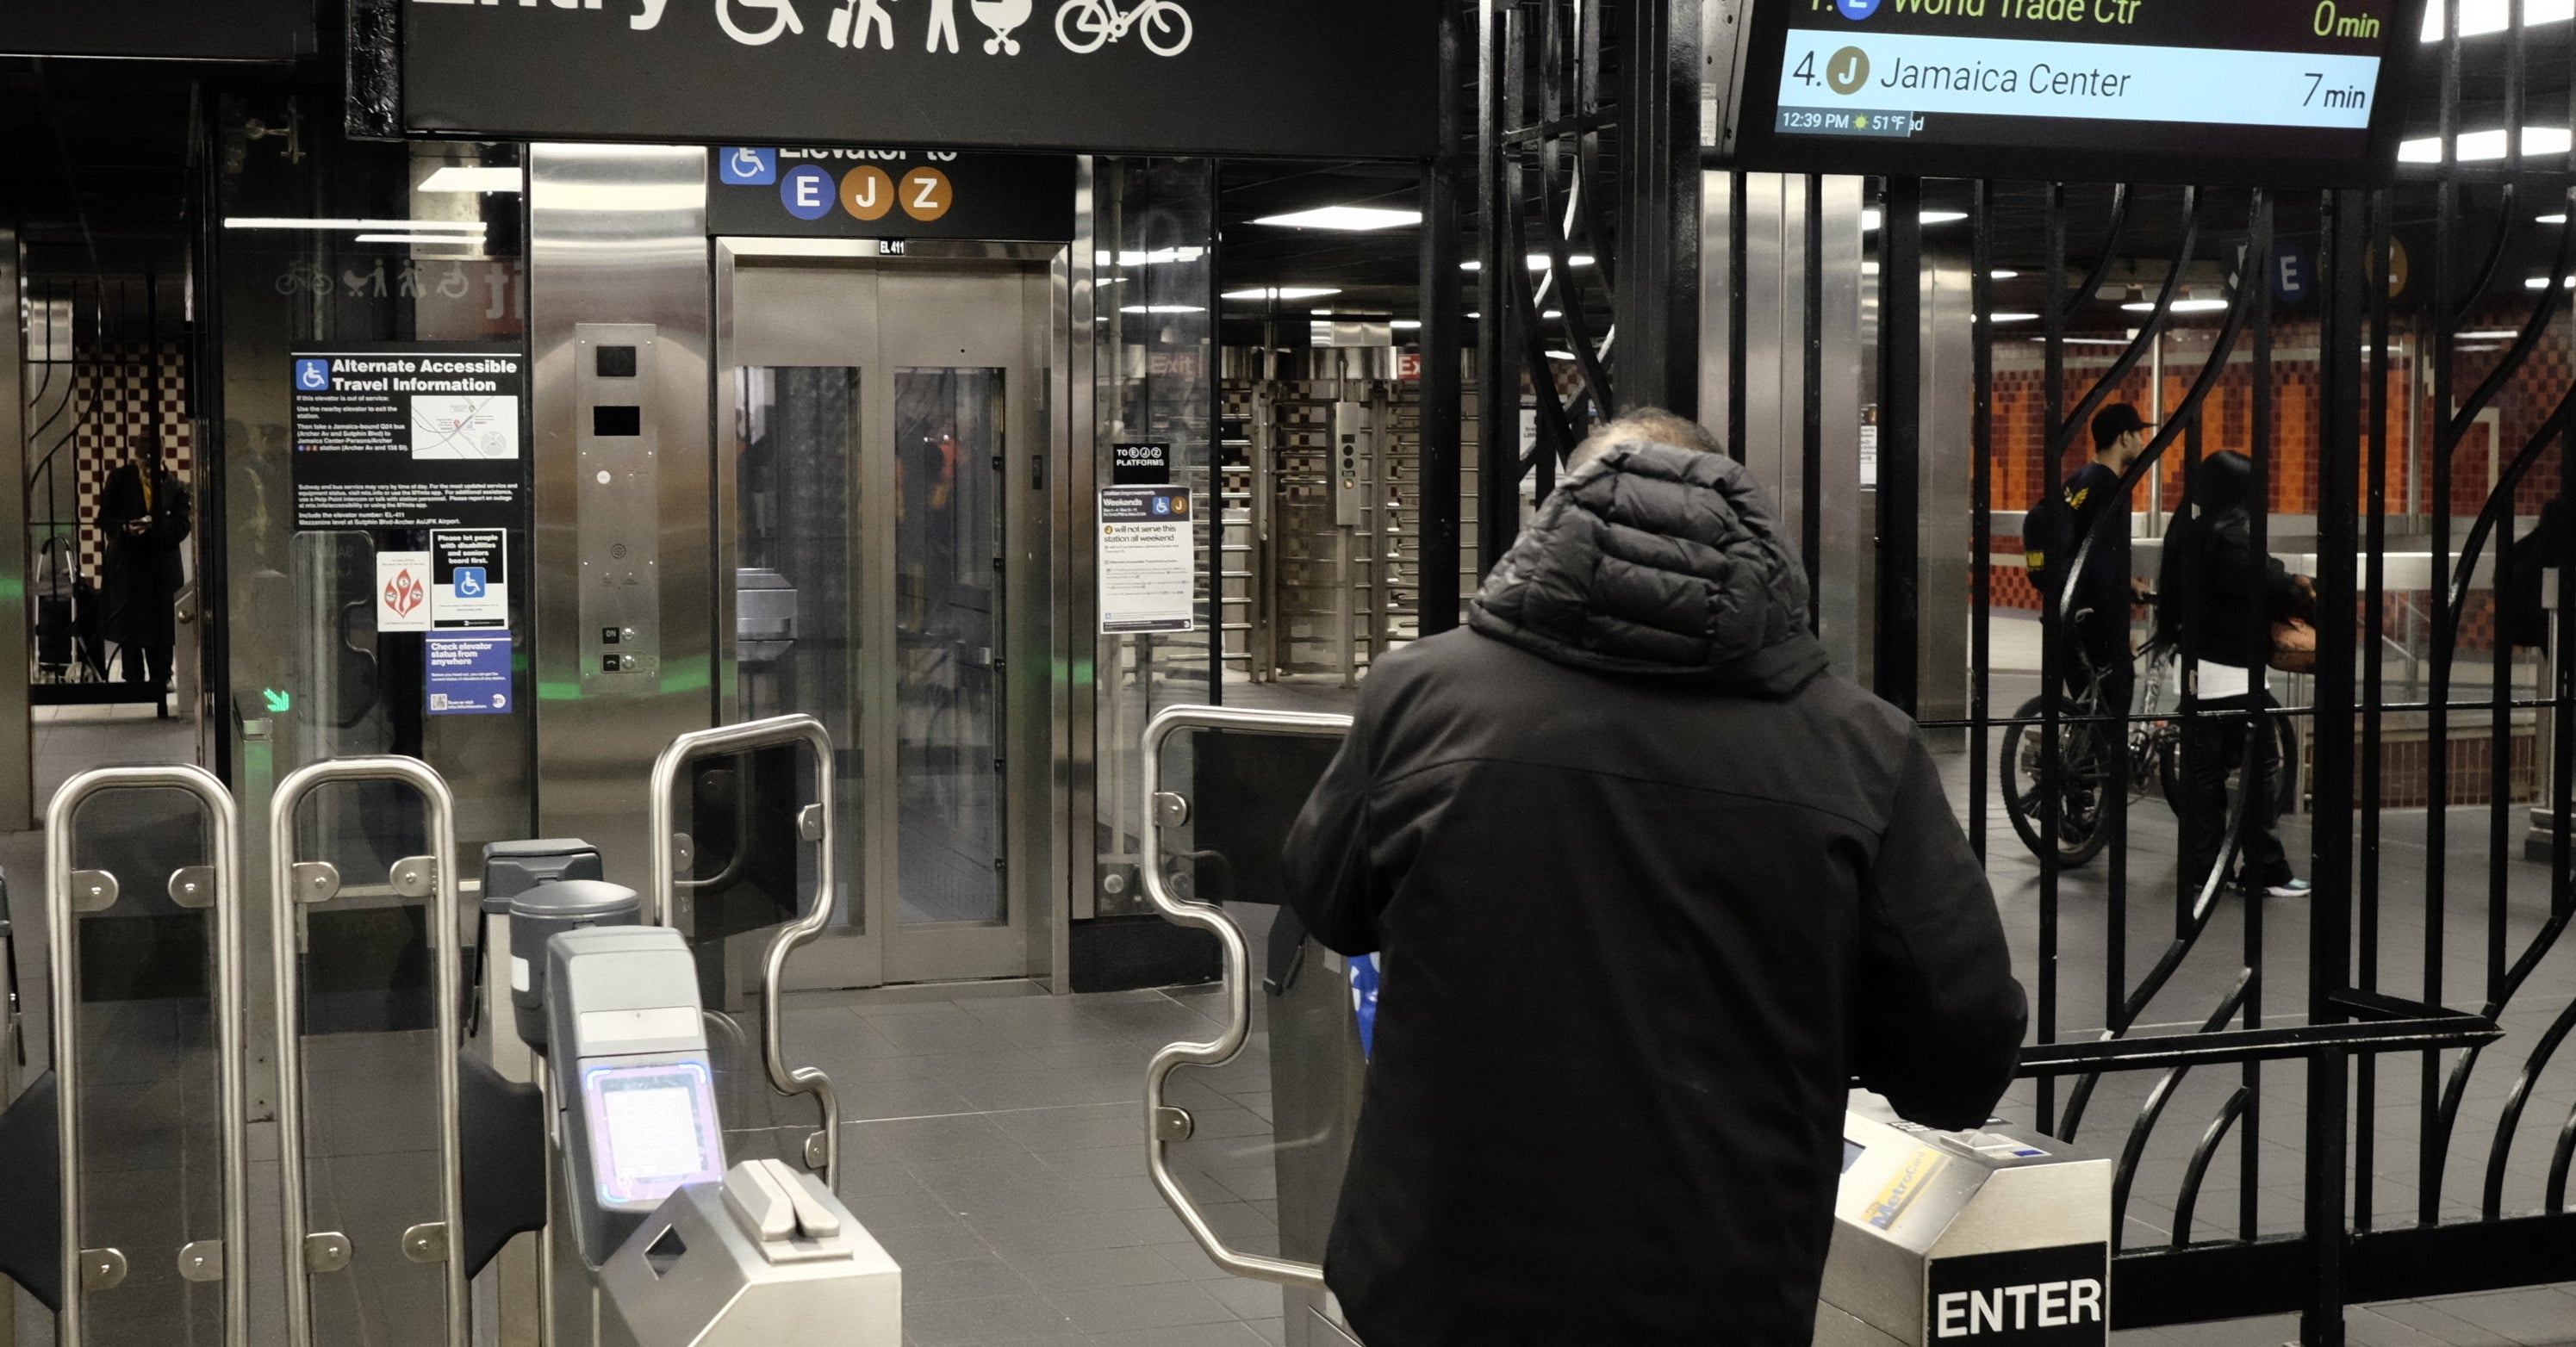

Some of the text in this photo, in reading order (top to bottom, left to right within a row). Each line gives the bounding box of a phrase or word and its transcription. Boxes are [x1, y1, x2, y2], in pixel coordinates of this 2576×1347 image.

[2094, 0, 2141, 24] Ctr
[2313, 1, 2336, 36] 0
[2336, 13, 2380, 38] min
[1792, 50, 1821, 87] 4.
[1881, 57, 2018, 93] Jamaica
[2029, 63, 2131, 96] Center
[2303, 72, 2323, 107] 7
[2324, 85, 2366, 109] min
[1783, 113, 1820, 127] 12:39
[1825, 115, 1849, 128] PM
[796, 176, 938, 208] E J Z
[880, 241, 904, 254] EL 411
[2280, 255, 2300, 291] E
[332, 359, 517, 373] Alternate Accessible
[332, 377, 496, 391] Travel Information
[431, 658, 472, 667] anywhere
[1870, 1151, 1925, 1230] MetroCard
[1938, 1278, 2101, 1338] ENTER
